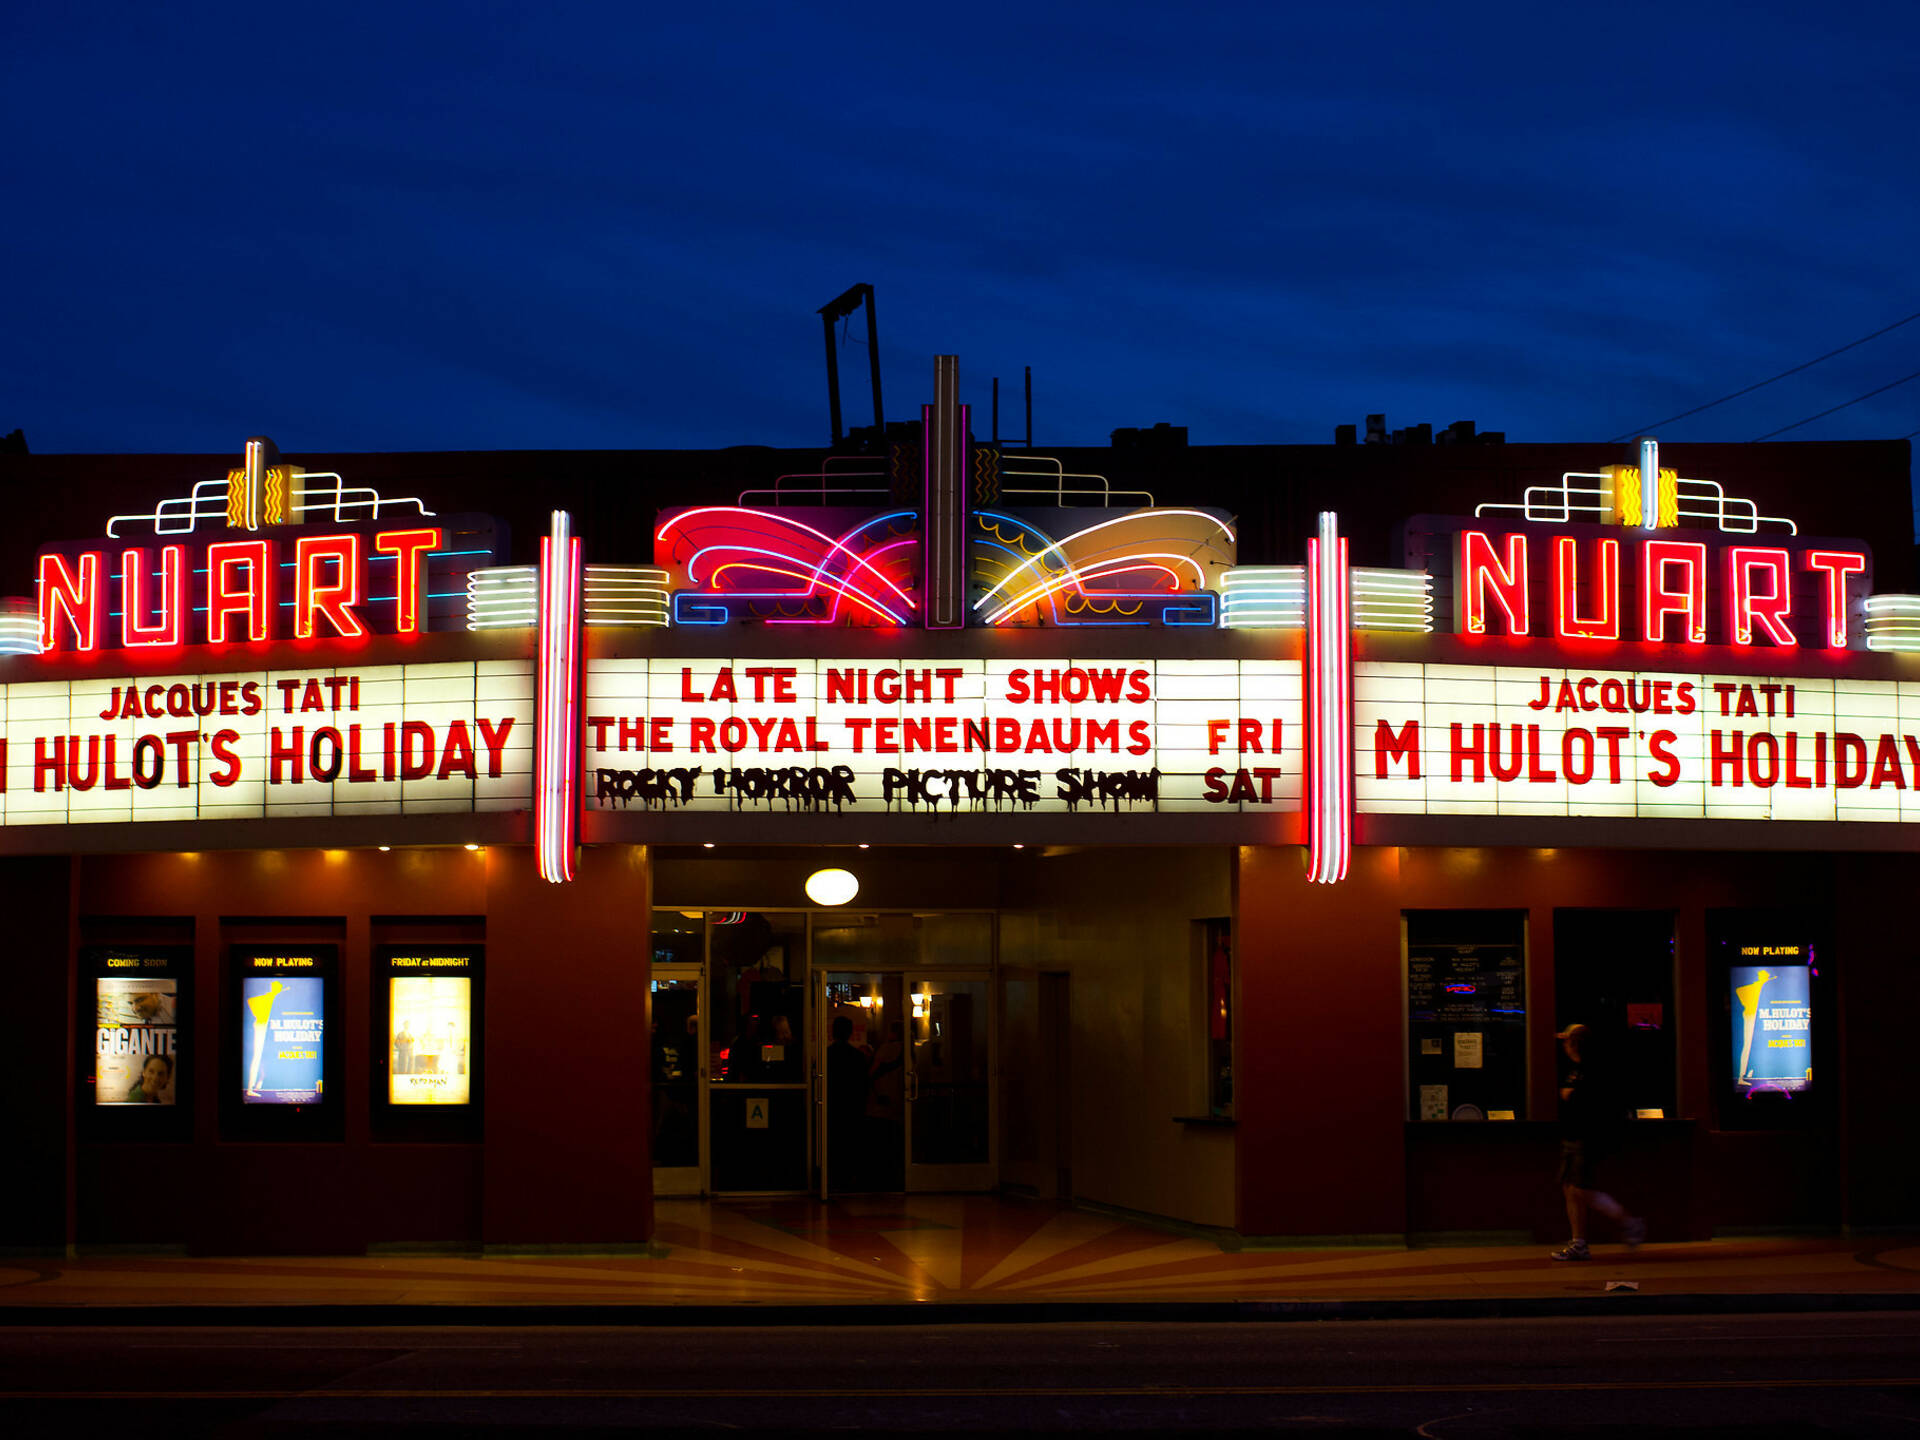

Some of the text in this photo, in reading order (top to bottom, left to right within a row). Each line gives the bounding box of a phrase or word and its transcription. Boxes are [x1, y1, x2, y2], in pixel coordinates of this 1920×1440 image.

[38, 528, 440, 652] NUART
[1463, 530, 1866, 648] NUART
[100, 676, 360, 719] JACQUES TATI
[682, 667, 1151, 703] LATE NIGHT SHOWS
[1529, 676, 1794, 717] JACQUES TATI
[588, 716, 1282, 755] THE ROYAL TENENBAUMS FRI
[1375, 719, 1420, 780] M
[1450, 722, 1681, 787] HULOT'S
[34, 728, 241, 792] HULOT'S
[270, 718, 515, 785] HOLIDAY
[596, 765, 1280, 818] ROCKY HORROR PICTURE SHOW SAT
[107, 958, 168, 968] COMING SOON
[254, 958, 314, 967] NOW PLAYING
[391, 958, 421, 967] FRIDAY
[429, 958, 470, 967] MIDNIGHT
[1741, 946, 1799, 956] NOW PLAYING
[274, 1030, 322, 1042] HOLIDAY
[1763, 1019, 1810, 1031] HOLIDAY
[751, 1104, 763, 1120] A
